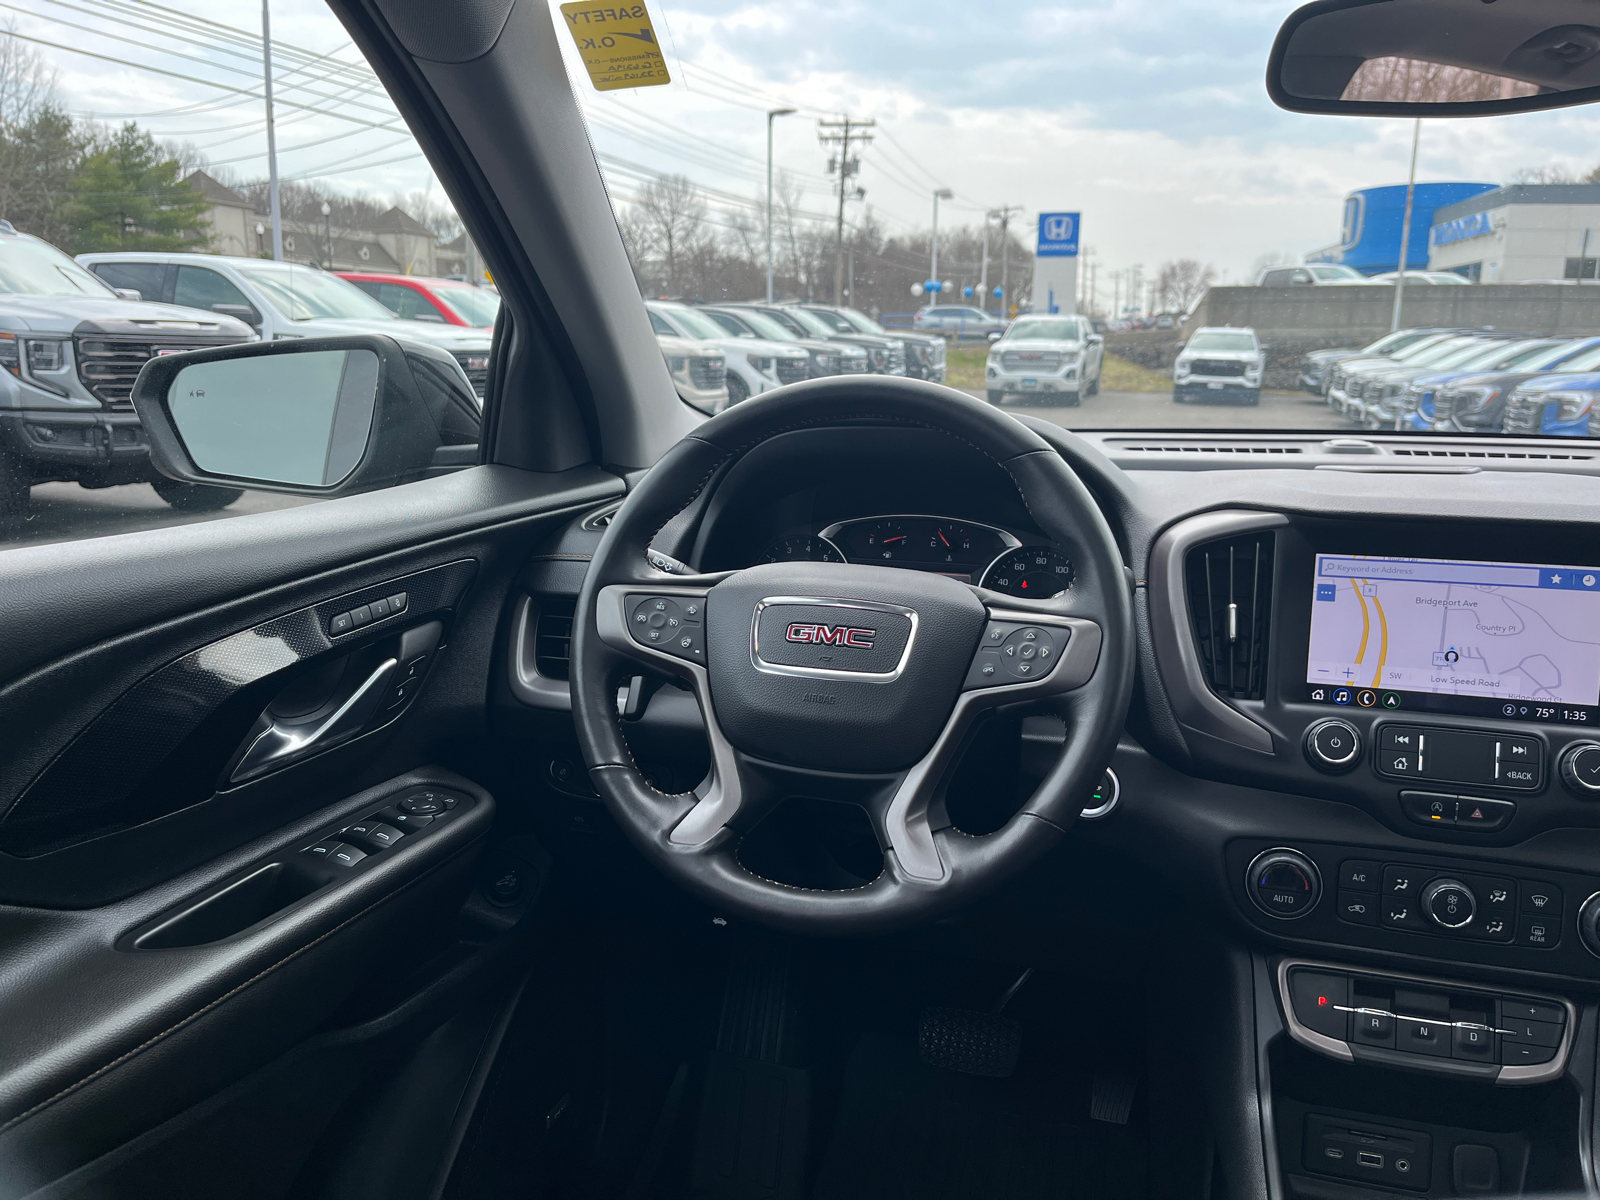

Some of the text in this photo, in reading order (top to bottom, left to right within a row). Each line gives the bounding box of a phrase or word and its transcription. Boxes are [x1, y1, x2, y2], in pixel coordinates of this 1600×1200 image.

[786, 545, 811, 554] 3 4
[823, 554, 829, 562] 5
[1036, 557, 1047, 565] 80
[1014, 563, 1025, 571] 60
[1055, 566, 1069, 574] 100
[1337, 564, 1370, 574] Keyword
[1381, 566, 1413, 575] Address
[997, 578, 1009, 586] 40
[1415, 596, 1479, 608] Bridgeport Ave
[1475, 623, 1507, 633] Country
[786, 623, 876, 650] GMC
[1389, 672, 1403, 680] SW
[1431, 675, 1500, 688] Low Speed Road
[1535, 707, 1587, 721] 75° 1:35
[1511, 771, 1533, 781] BACK
[1352, 873, 1366, 883] A/C
[1273, 894, 1294, 904] AUTO
[1529, 935, 1546, 943] REAR
[1318, 996, 1327, 1006] P
[1371, 1018, 1379, 1028] R
[1420, 1027, 1428, 1037] N
[1469, 1032, 1478, 1042] D
[1526, 1027, 1533, 1037] L
